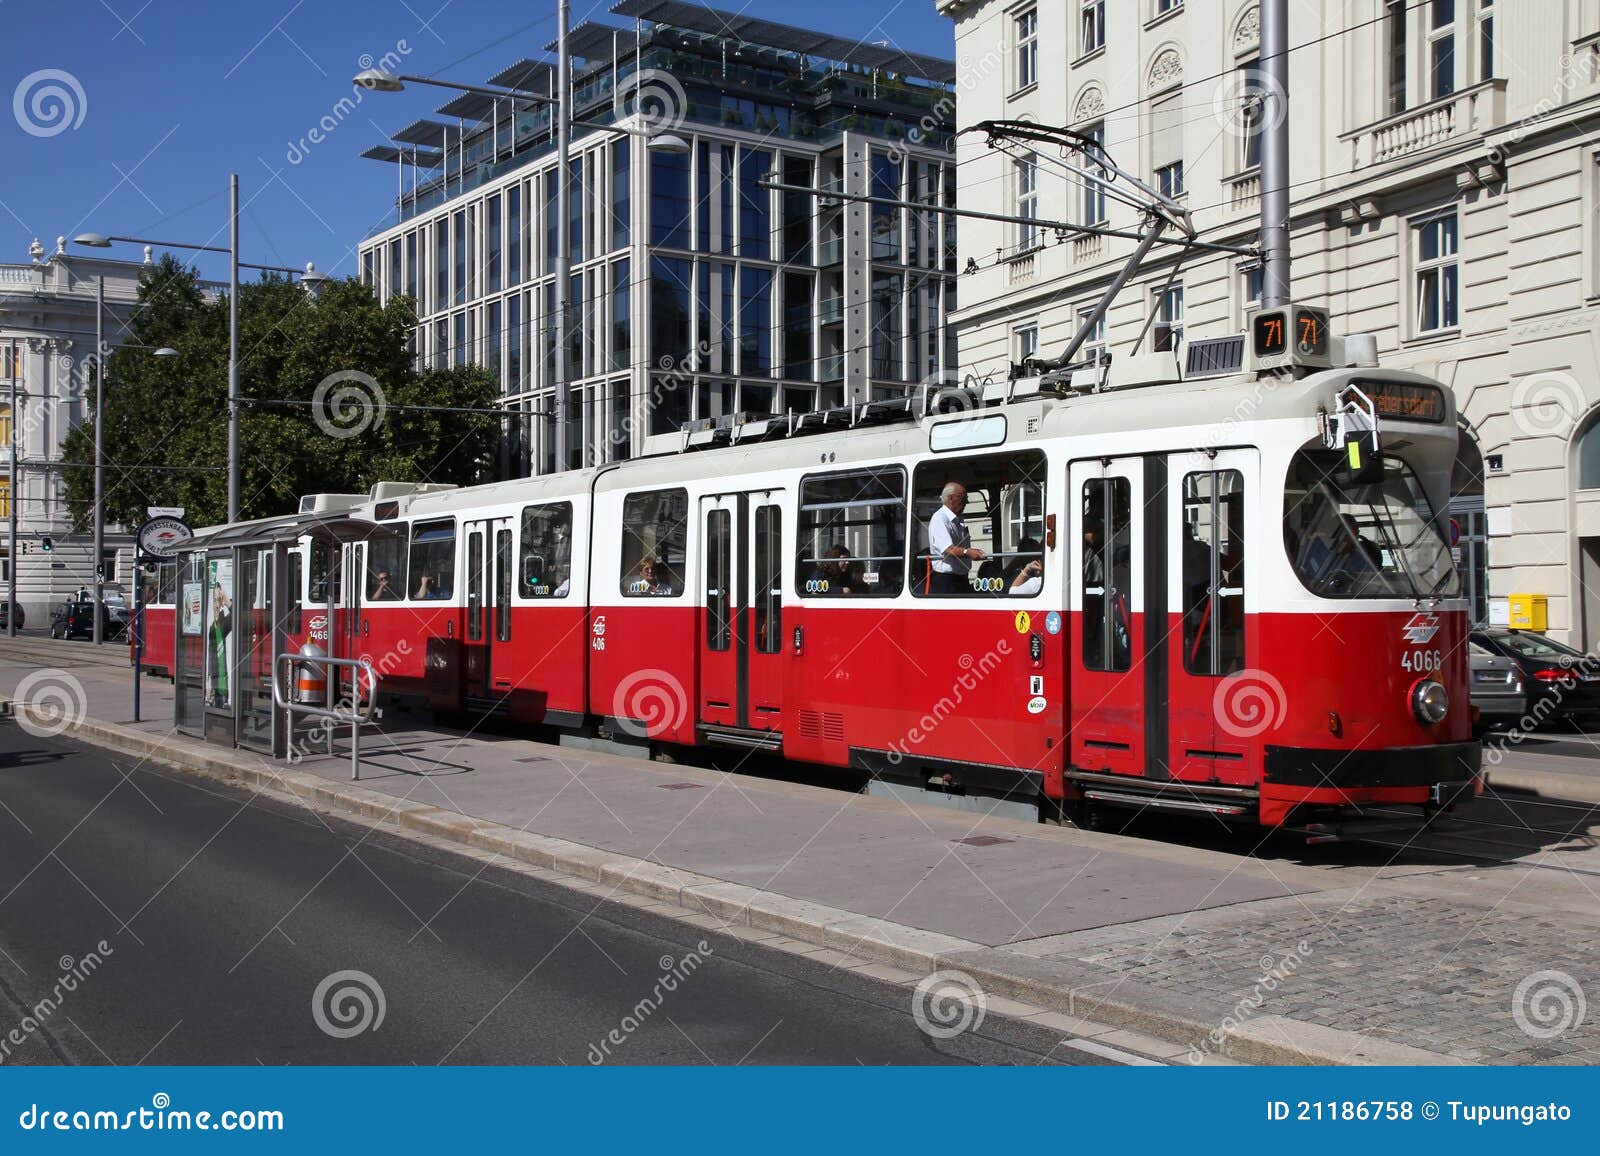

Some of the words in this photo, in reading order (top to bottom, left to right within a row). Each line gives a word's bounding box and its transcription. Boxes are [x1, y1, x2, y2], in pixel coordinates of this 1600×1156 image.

[1264, 319, 1281, 347] 71
[1300, 318, 1317, 345] 71
[309, 630, 328, 640] 1466
[1401, 649, 1441, 672] 4066
